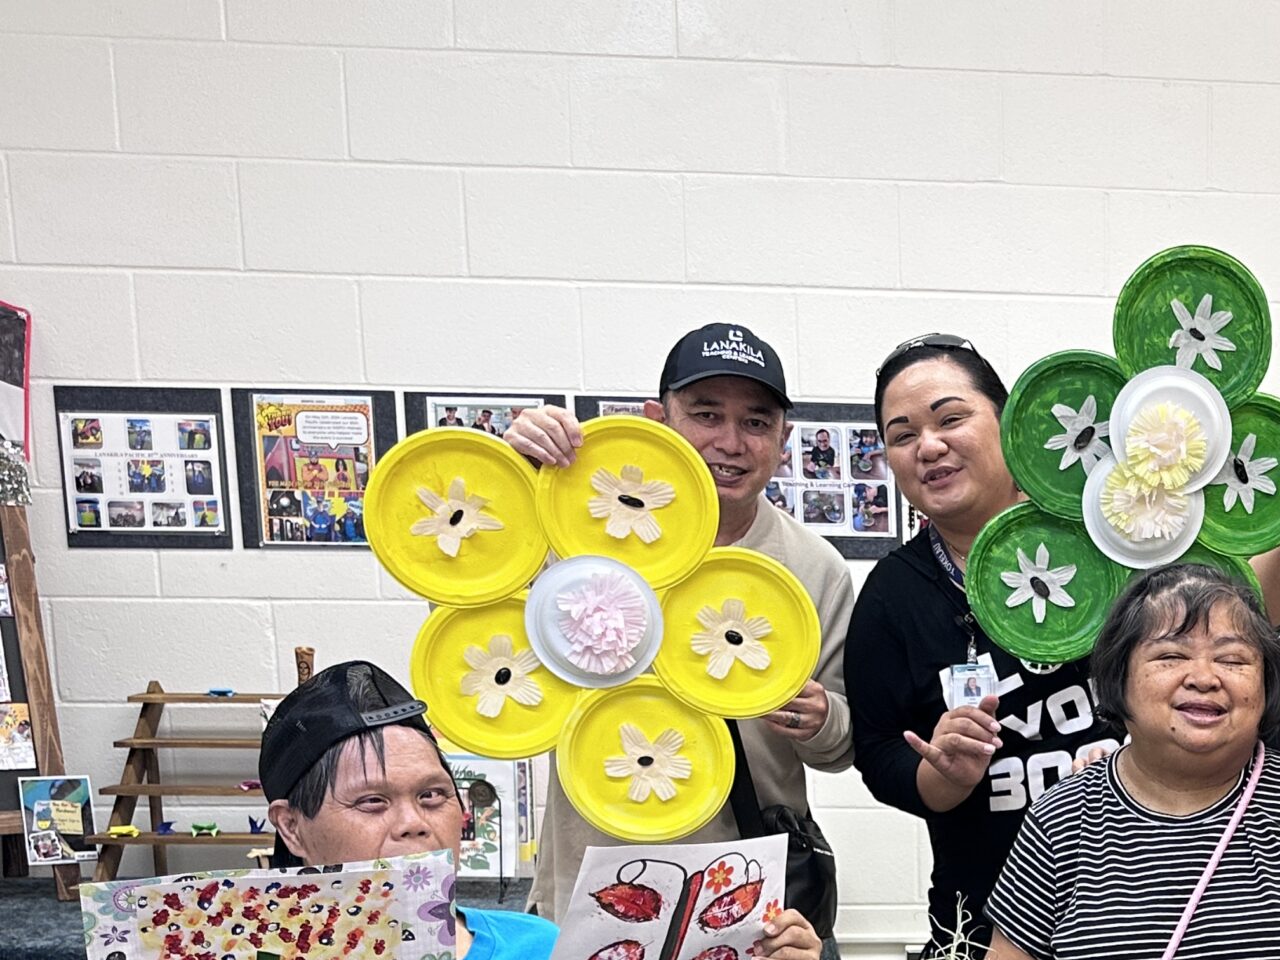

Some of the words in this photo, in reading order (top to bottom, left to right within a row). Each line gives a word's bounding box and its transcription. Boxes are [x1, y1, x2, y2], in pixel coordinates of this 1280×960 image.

[703, 340, 765, 362] LANAKILA
[932, 542, 955, 577] TOKELAU
[1000, 677, 1101, 741] VO
